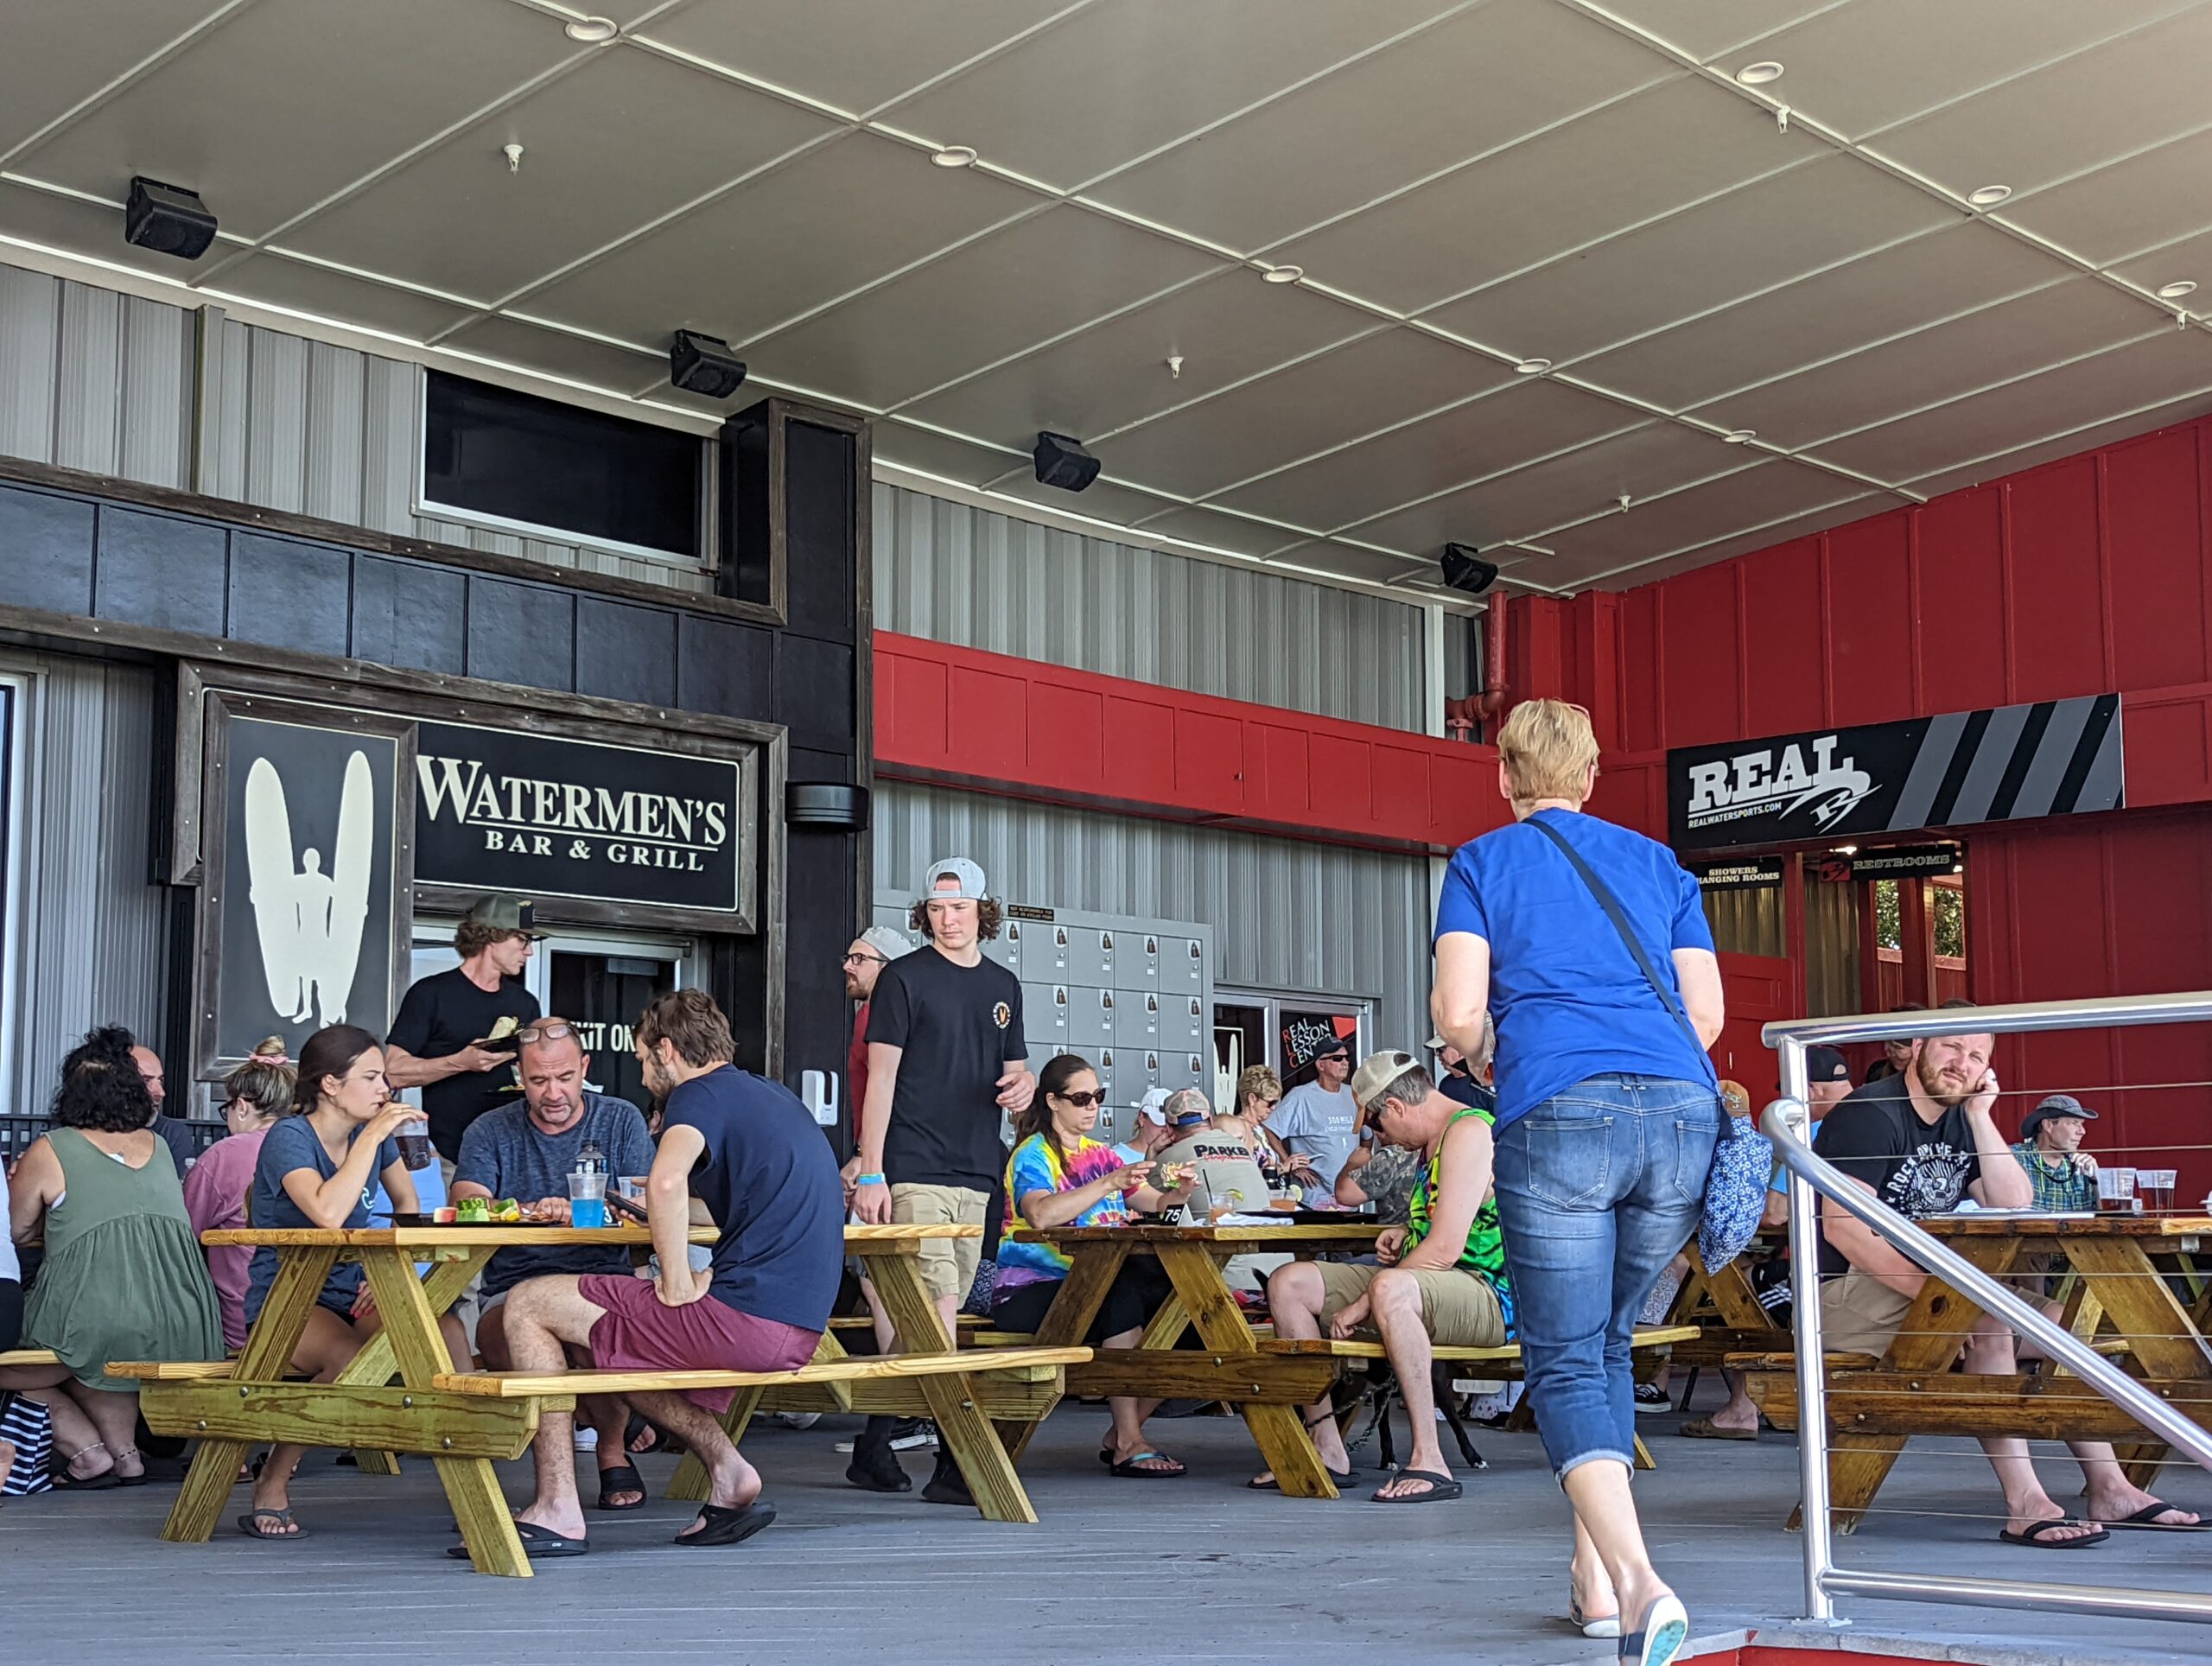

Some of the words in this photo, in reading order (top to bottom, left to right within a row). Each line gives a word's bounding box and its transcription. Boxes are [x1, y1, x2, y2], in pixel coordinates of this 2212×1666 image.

[1688, 734, 1854, 813] REAL
[416, 754, 727, 845] WATERMEN'S
[1688, 801, 1783, 830] REALWATERSPORTS.COM
[485, 830, 553, 856] BAR
[569, 840, 592, 860] &
[607, 843, 704, 872] GRILL
[1853, 855, 1950, 870] RESTROOMS
[1708, 866, 1758, 876] SHOWERS
[1742, 872, 1780, 881] ROOMS
[570, 1021, 607, 1051] XIT
[610, 1023, 637, 1052] ON
[1282, 1017, 1311, 1044] REAL
[1285, 1020, 1330, 1058] LESSON
[1164, 1209, 1182, 1223] 75
